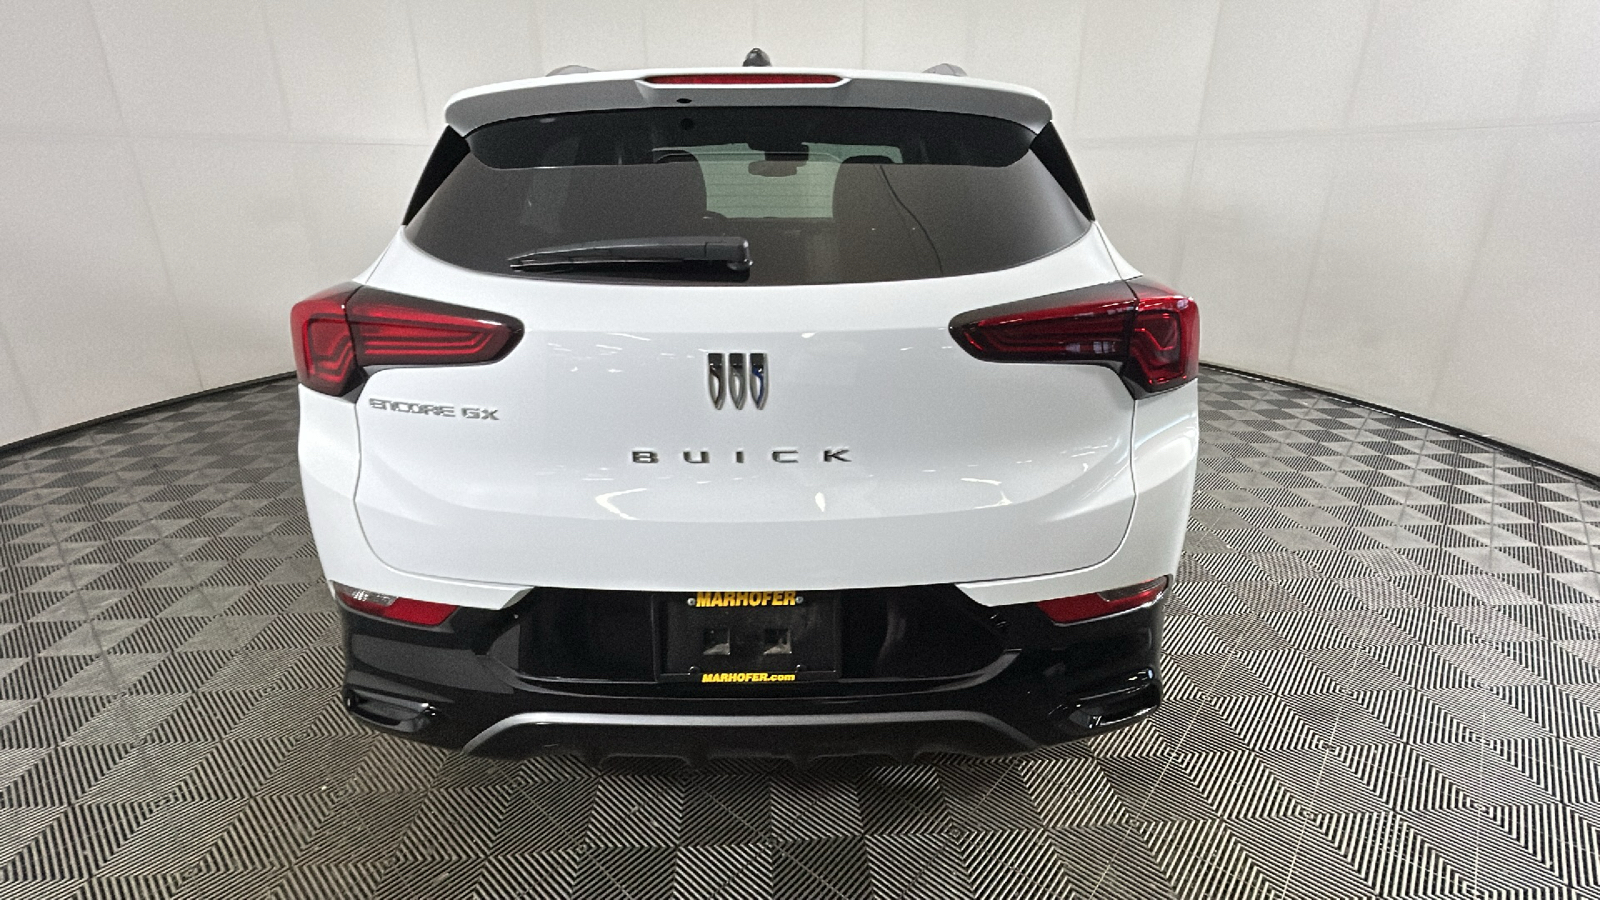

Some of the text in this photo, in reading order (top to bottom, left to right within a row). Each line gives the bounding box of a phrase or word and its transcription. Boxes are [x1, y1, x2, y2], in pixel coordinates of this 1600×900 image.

[369, 398, 500, 420] ENCORE GX
[631, 449, 852, 464] BUICK
[695, 590, 796, 608] MARHOFER
[702, 672, 796, 683] MARHOFER.com
